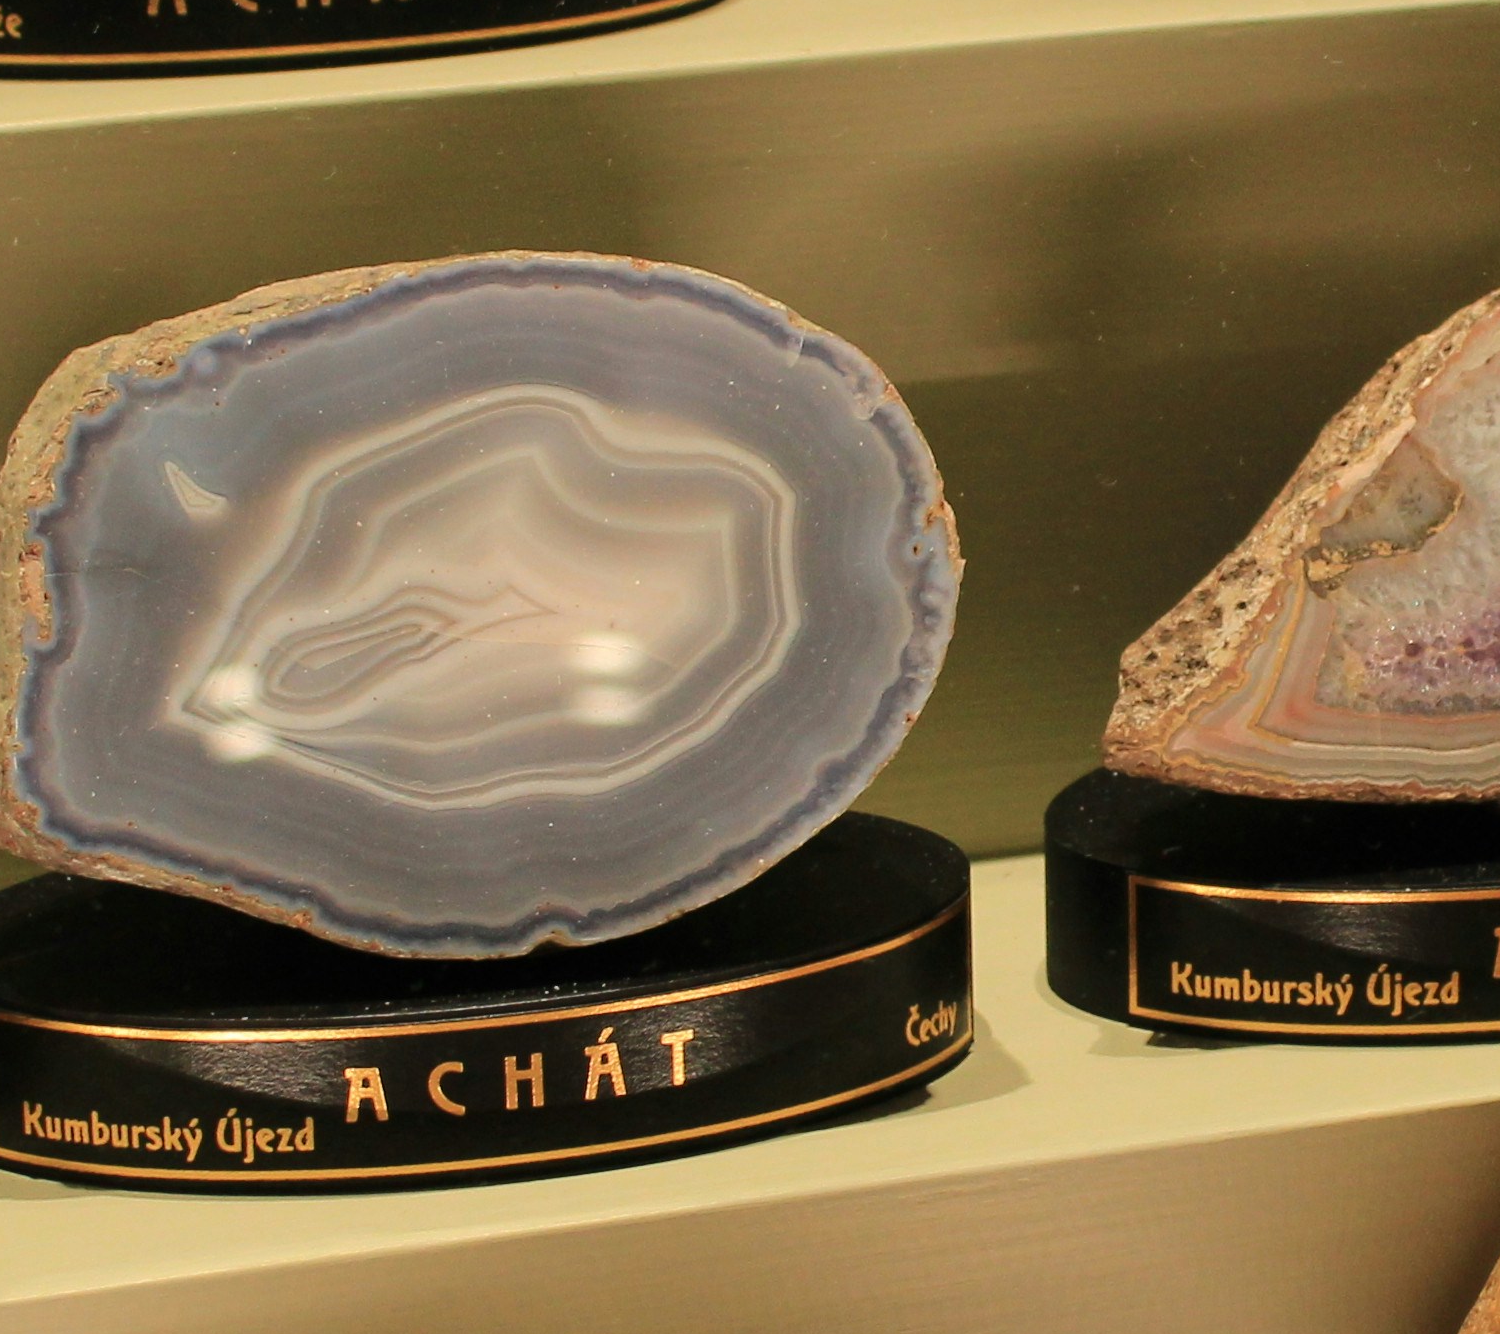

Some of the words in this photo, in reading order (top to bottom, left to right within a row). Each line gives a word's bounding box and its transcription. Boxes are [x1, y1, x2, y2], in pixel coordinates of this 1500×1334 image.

[1171, 961, 1354, 1014] Kumburský
[1366, 963, 1460, 1017] Újezd
[905, 1002, 957, 1047] Čechy
[345, 1029, 695, 1121] ACHÁT
[24, 1101, 203, 1162] Kumburský
[215, 1107, 314, 1162] Újezd
